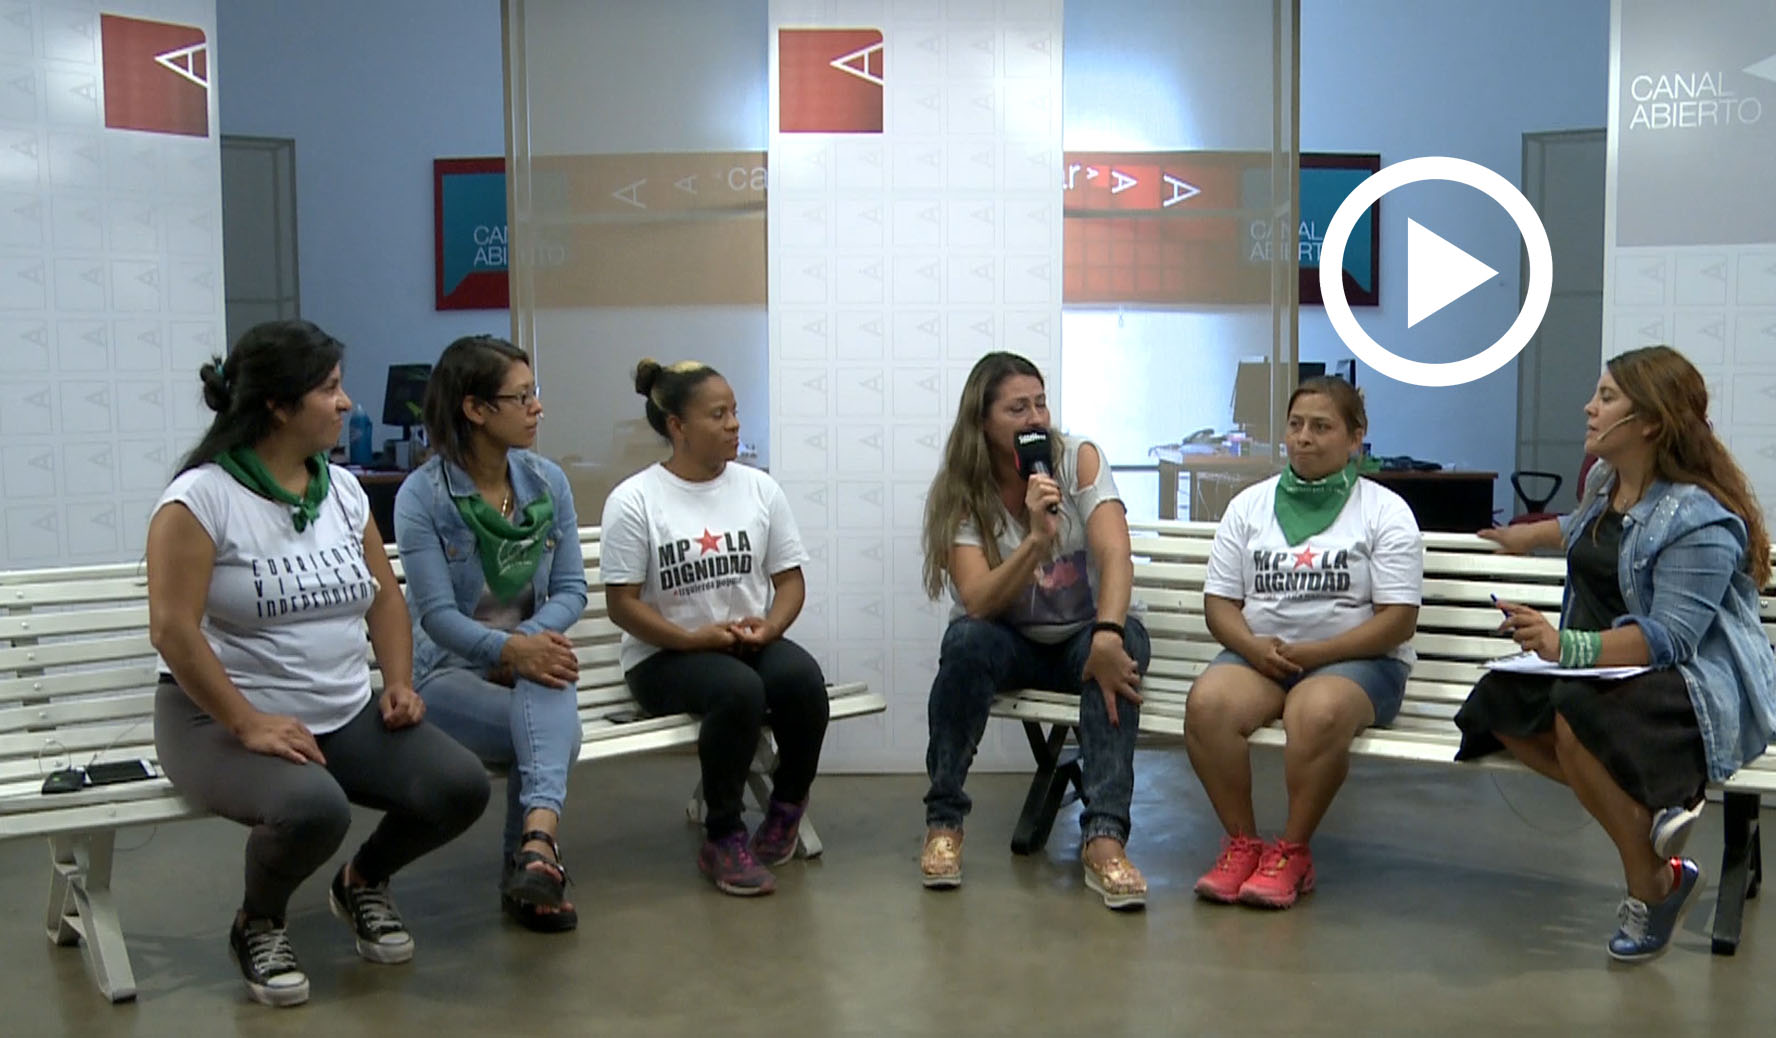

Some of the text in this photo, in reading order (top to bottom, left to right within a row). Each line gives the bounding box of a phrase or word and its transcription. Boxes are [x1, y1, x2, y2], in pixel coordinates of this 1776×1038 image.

[1631, 71, 1736, 102] CANAL
[1629, 97, 1762, 130] ABIERTO
[658, 530, 751, 568] MP LA
[1321, 549, 1348, 569] LA
[660, 553, 752, 591] DIGNIDAD
[1255, 571, 1350, 593] DIGNIDAD
